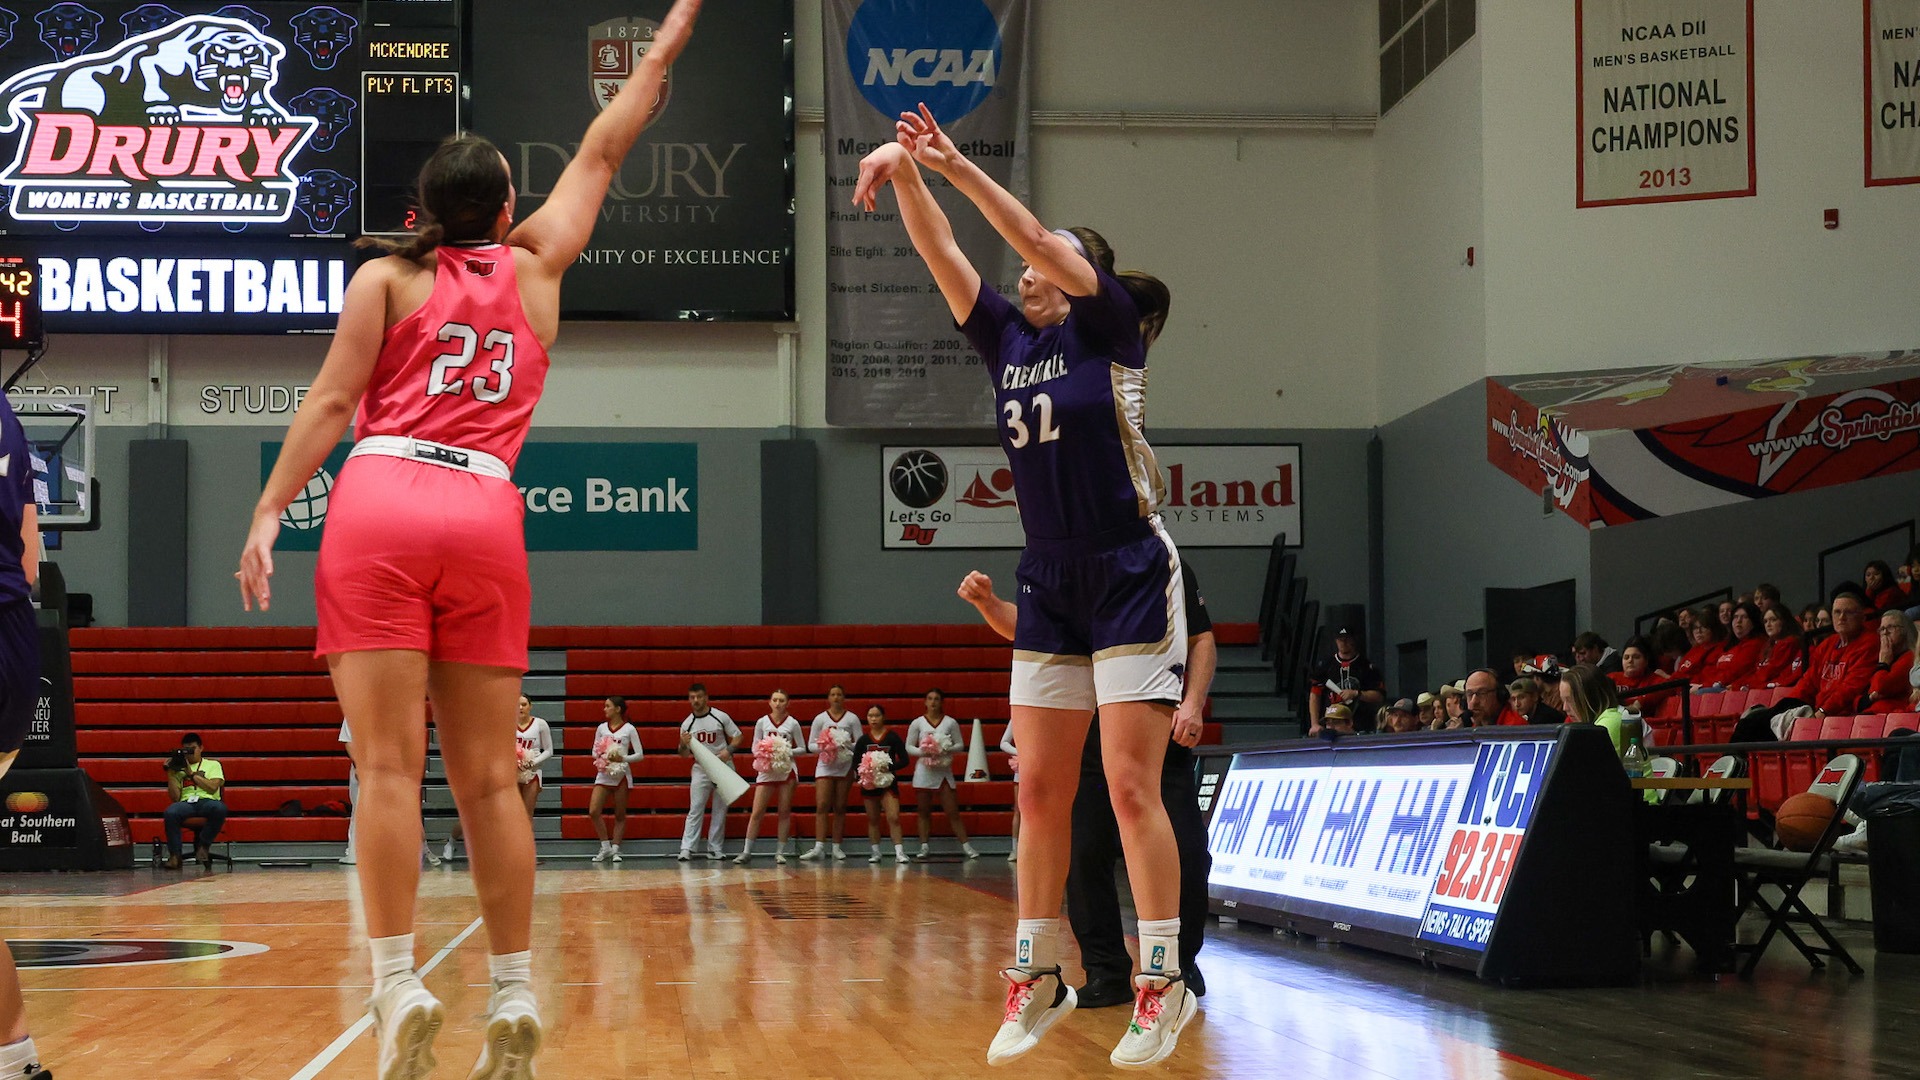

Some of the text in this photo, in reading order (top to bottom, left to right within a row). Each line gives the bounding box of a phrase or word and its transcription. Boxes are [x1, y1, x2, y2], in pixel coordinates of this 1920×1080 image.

[607, 26, 653, 38] 1873
[1621, 20, 1706, 42] NCAA DII
[1882, 27, 1920, 40] MEN'
[369, 42, 449, 59] MCKENDREE
[1592, 44, 1736, 68] MEN'S BASKETBALL
[863, 47, 996, 87] NCAA
[367, 77, 453, 94] PLY FL PTS
[1603, 78, 1726, 113] NATIONAL
[1592, 116, 1740, 154] CHAMPIONS
[20, 113, 301, 183] DRURY
[955, 139, 1015, 158] etball
[515, 142, 747, 201] DURY
[1639, 167, 1692, 189] 2013
[28, 191, 280, 212] WOMEN'S BASKETBALL
[830, 211, 860, 221] Final
[631, 249, 656, 264] OF
[664, 249, 780, 264] EXCELLENCE
[830, 246, 852, 257] Elite
[894, 247, 920, 257] 201
[830, 283, 867, 294] Sweet
[870, 283, 922, 294] Sixteen:
[830, 340, 869, 351] Region
[425, 321, 515, 404] 23
[1003, 392, 1061, 449] 32
[586, 477, 691, 513] Bank
[1157, 463, 1296, 507] land
[889, 510, 952, 523] Let's Go
[899, 523, 938, 545] DU
[0, 814, 76, 828] at Southern
[11, 830, 43, 843] Bank
[1435, 829, 1499, 901] 92.3
[1423, 909, 1446, 936] NEWS
[1447, 913, 1470, 940] TALK
